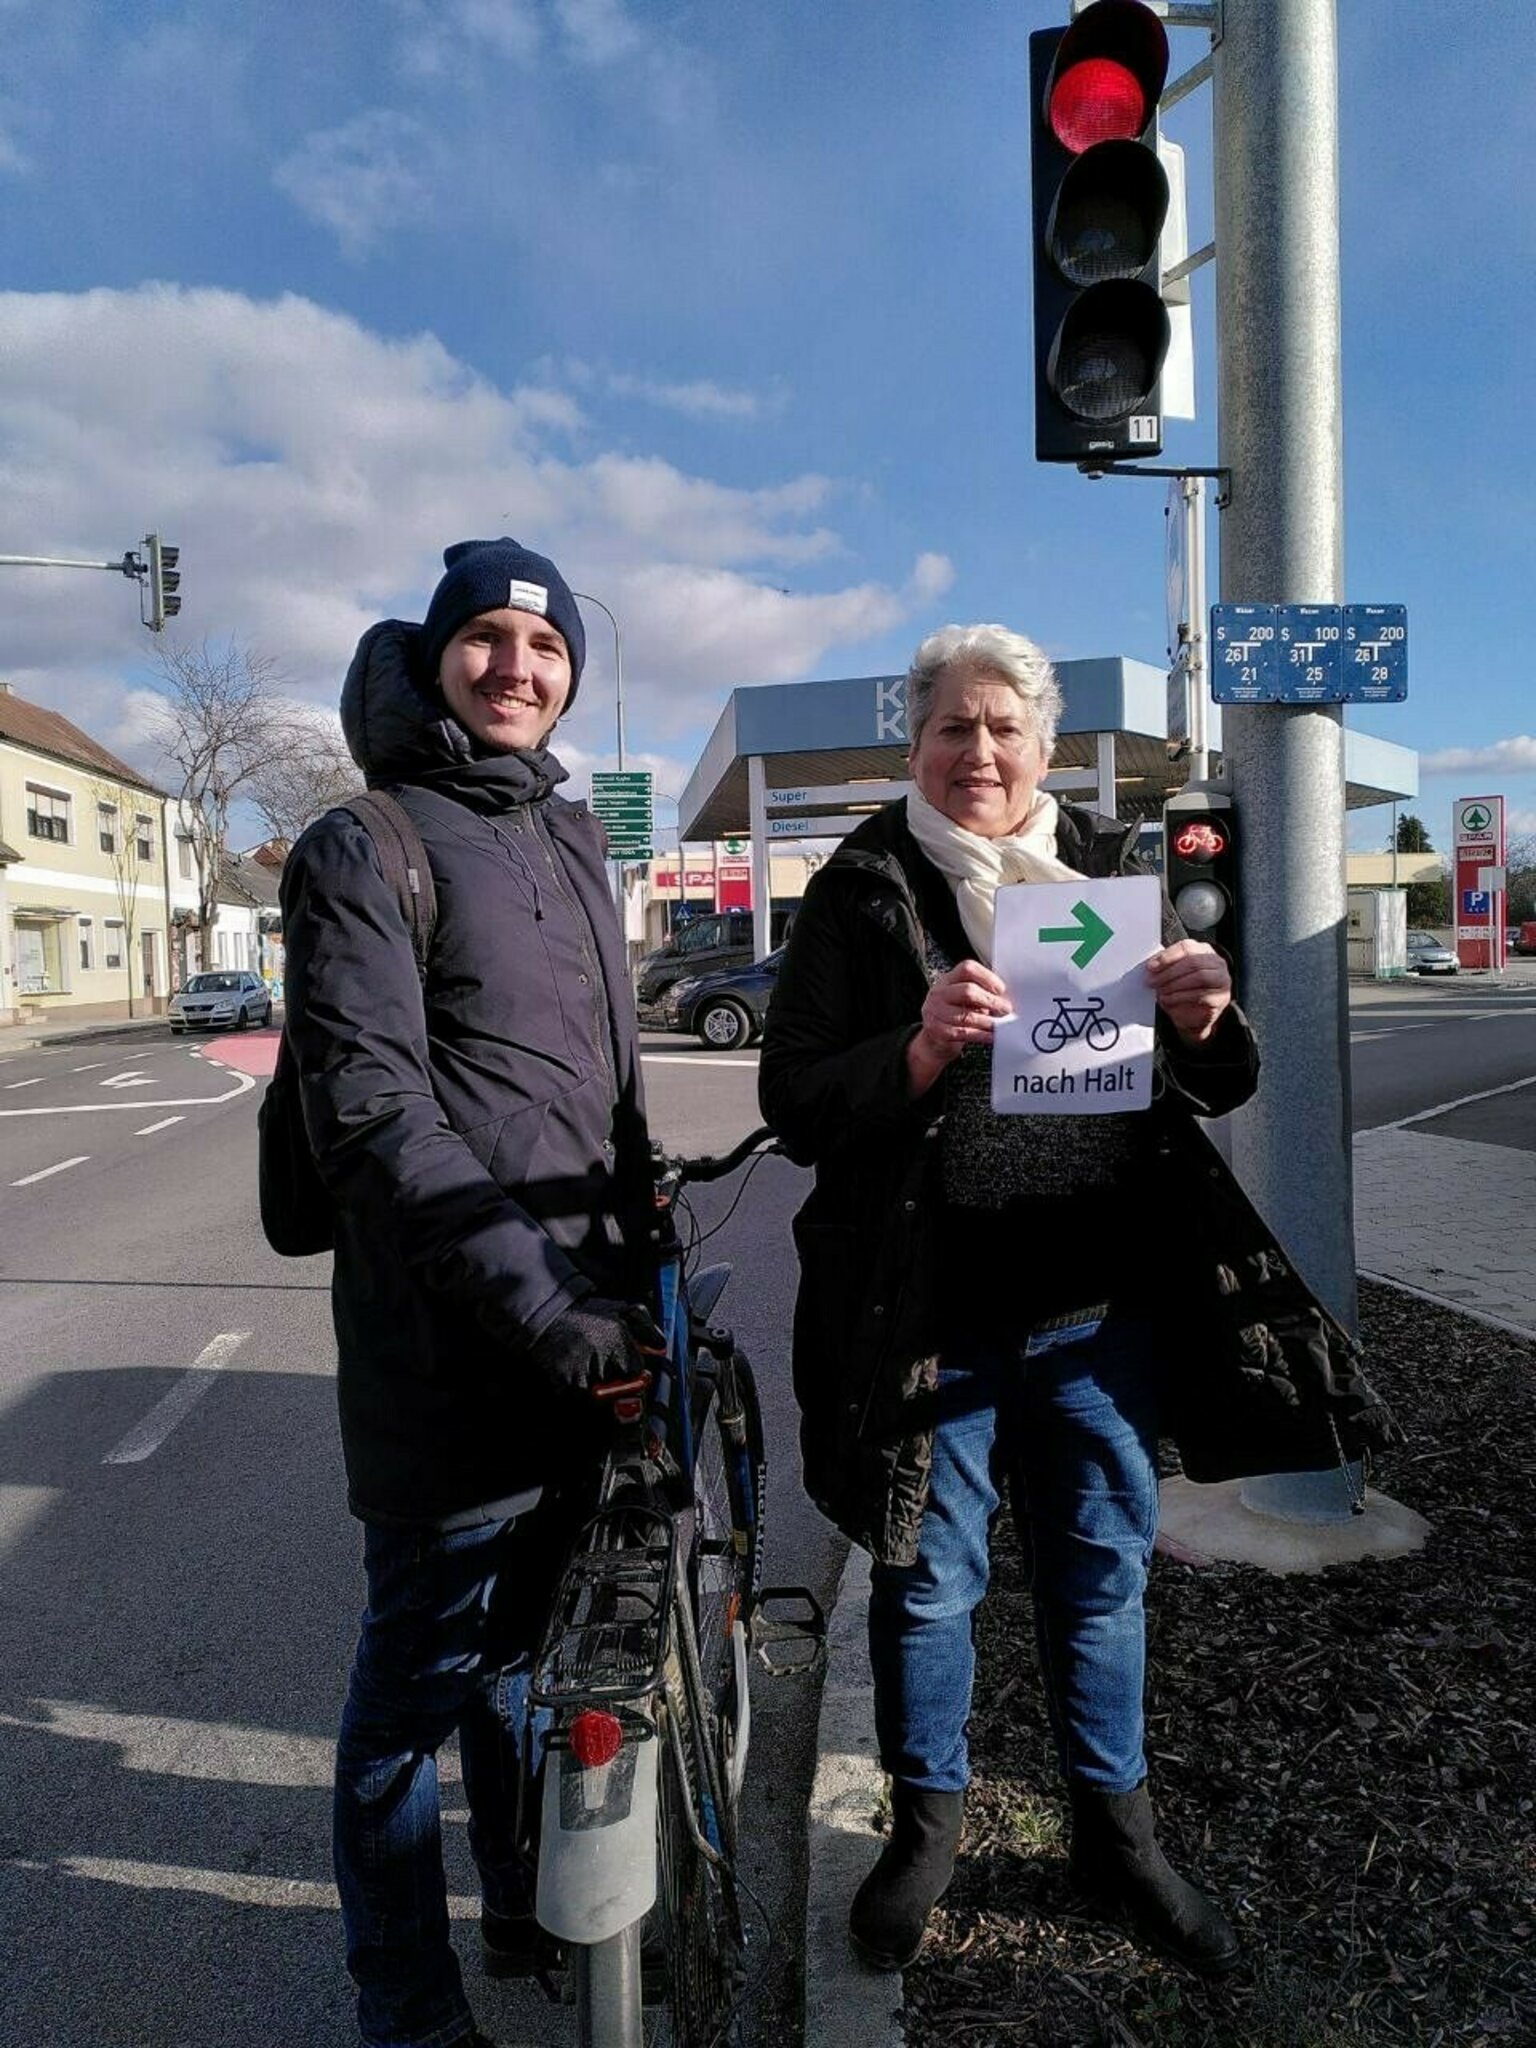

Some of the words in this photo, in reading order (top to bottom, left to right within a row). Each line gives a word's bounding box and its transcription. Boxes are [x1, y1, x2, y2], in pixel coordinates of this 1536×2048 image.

[1134, 418, 1153, 440] 11
[1217, 627, 1225, 640] S
[1249, 627, 1274, 640] 200
[1281, 627, 1290, 640] S
[1315, 627, 1339, 640] 100
[1347, 627, 1356, 640] S
[1380, 627, 1404, 640] 200
[772, 791, 808, 804] Super
[772, 820, 809, 832] Diesel
[674, 872, 714, 887] SPA
[1013, 1068, 1075, 1093] nach
[1084, 1065, 1135, 1093] Halt
